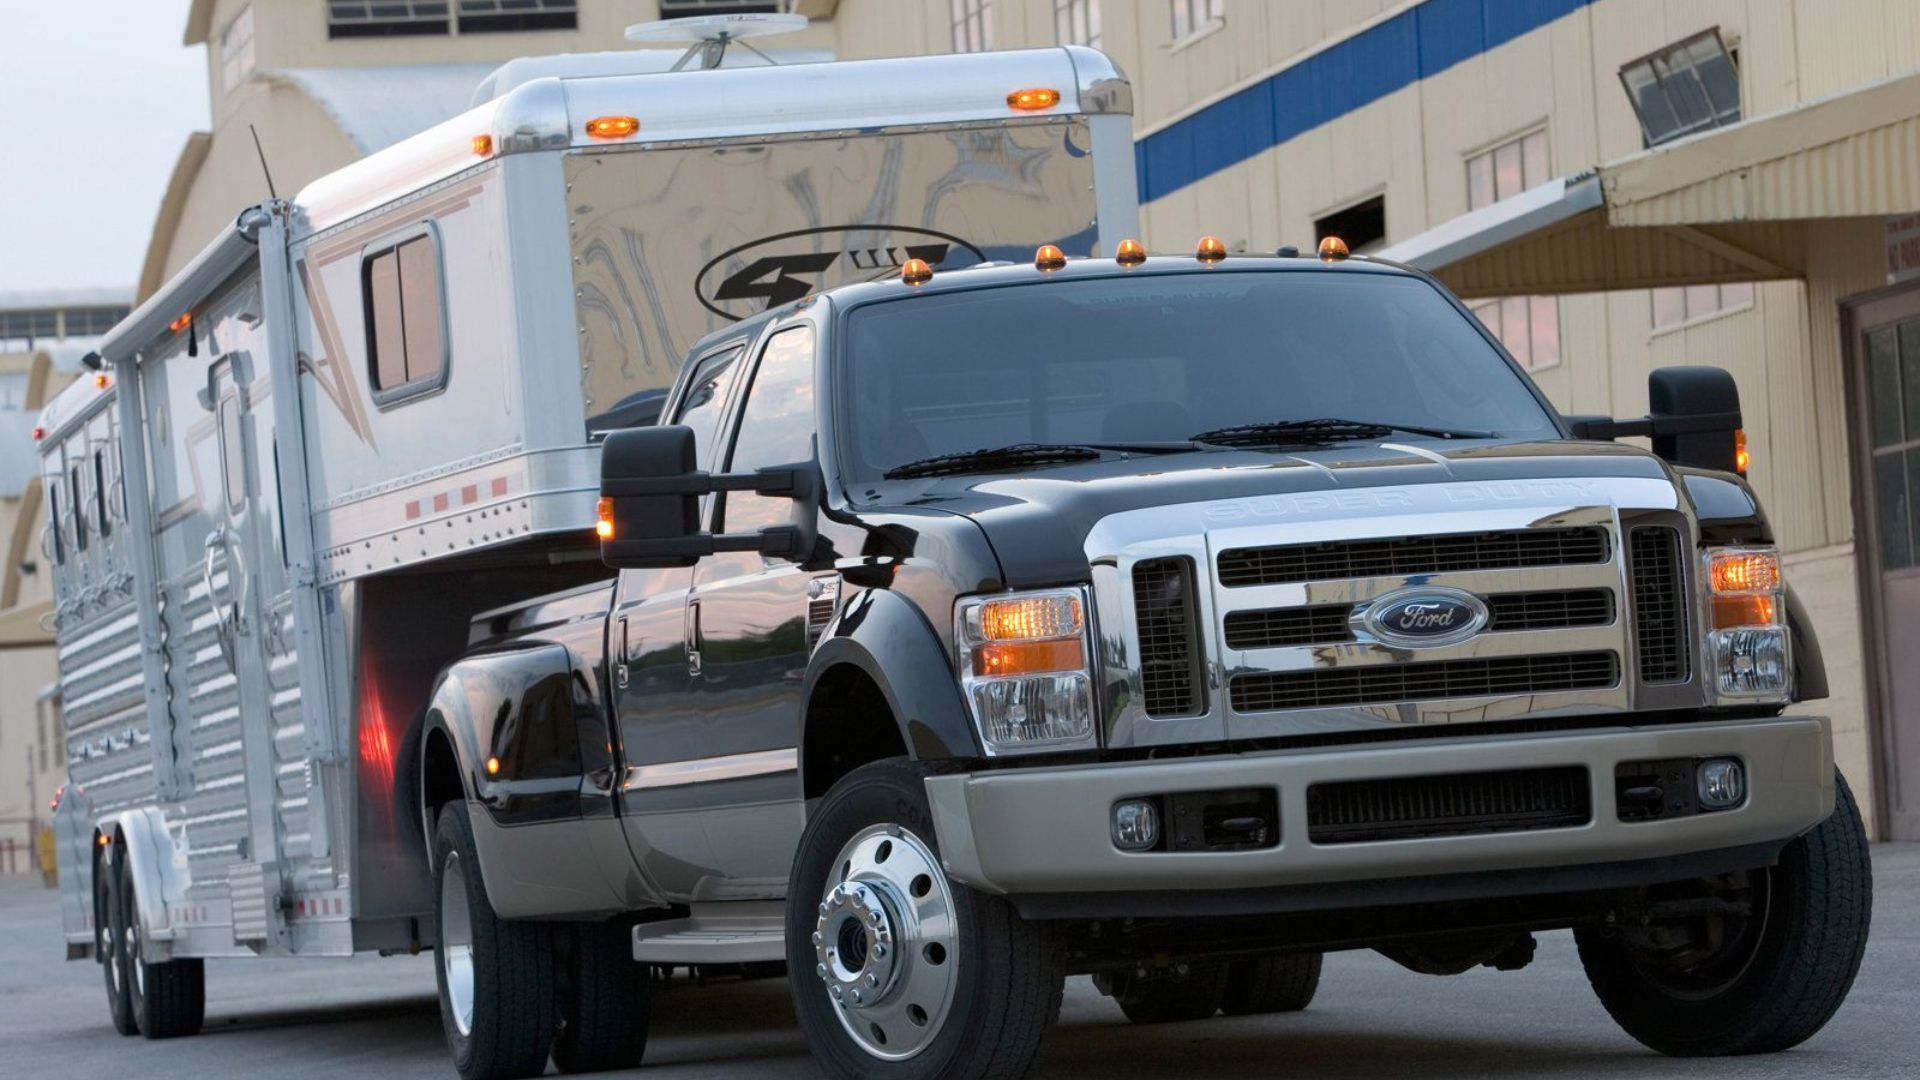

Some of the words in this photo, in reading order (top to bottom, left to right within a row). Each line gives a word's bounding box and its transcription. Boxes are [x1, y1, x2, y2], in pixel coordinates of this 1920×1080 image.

[1204, 489, 1414, 521] SUPER
[1444, 481, 1598, 503] DUTY
[1400, 603, 1454, 629] Ford
